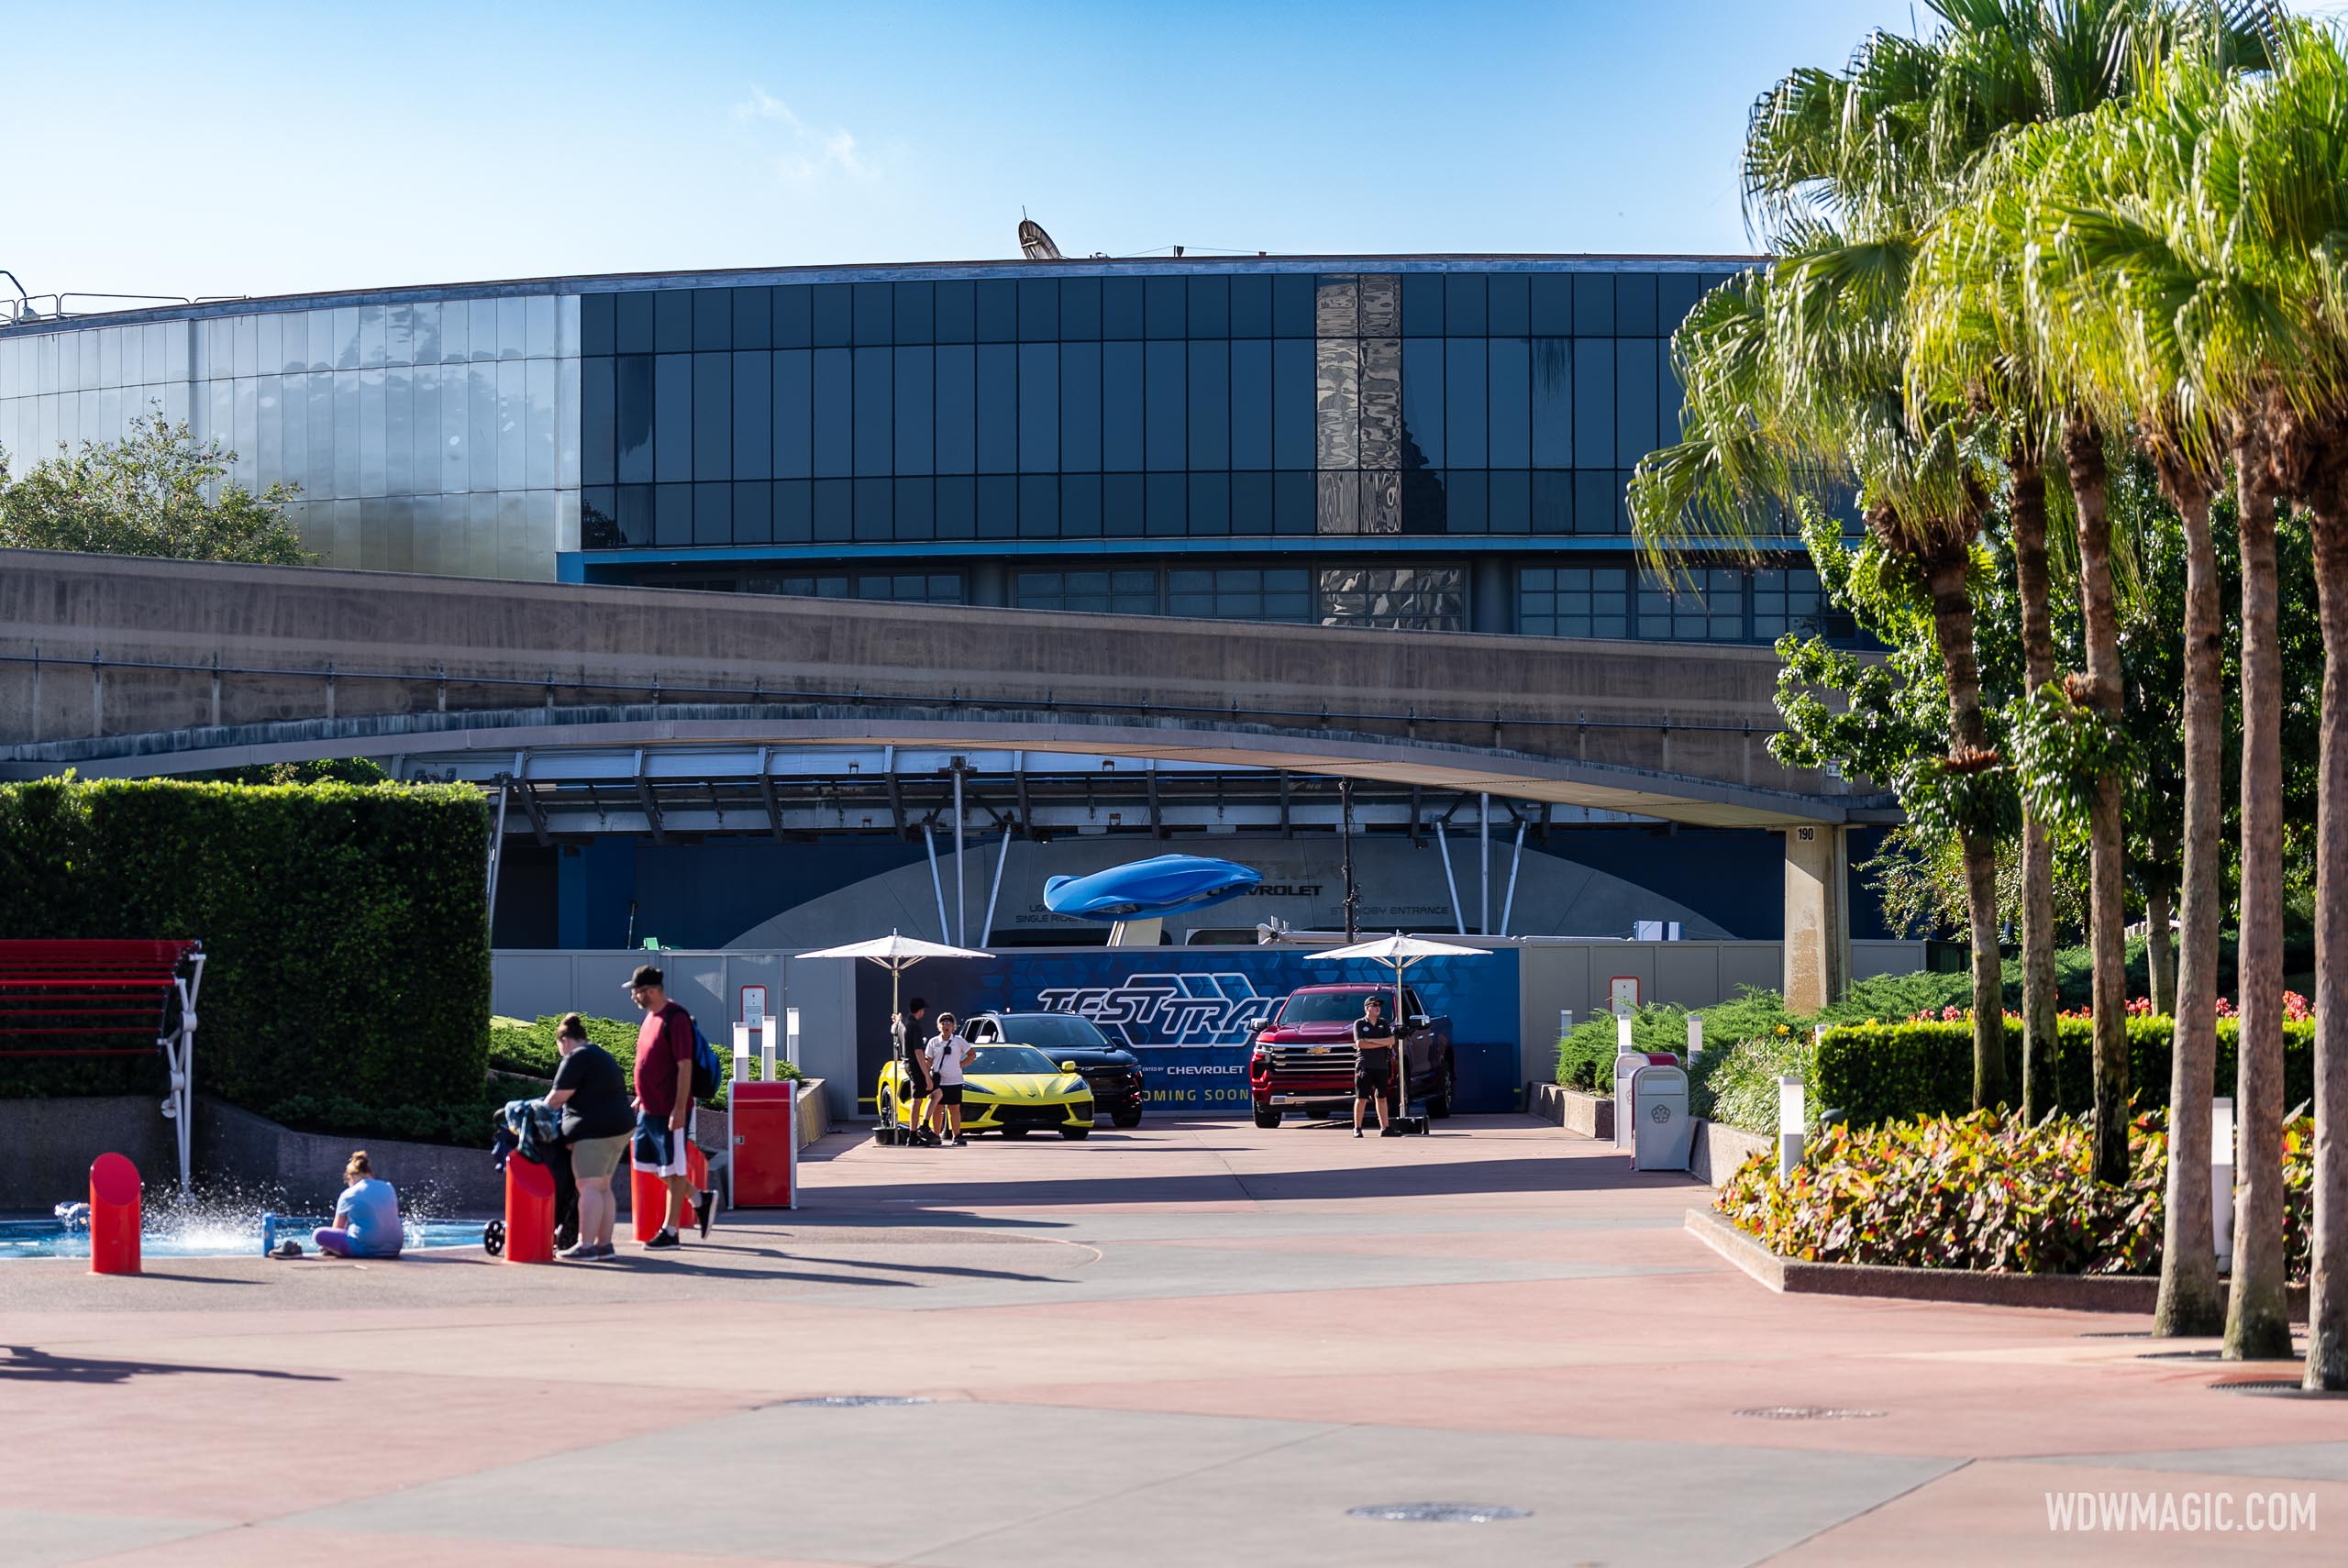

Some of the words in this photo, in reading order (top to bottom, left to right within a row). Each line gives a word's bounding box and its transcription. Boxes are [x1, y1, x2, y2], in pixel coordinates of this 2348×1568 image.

[1798, 827, 1814, 841] 190
[1390, 906, 1449, 915] ENTRANCE
[1015, 914, 1048, 923] SINGLE
[1037, 988, 1178, 1024] TEST
[1167, 1066, 1246, 1075] CHEVROLET
[1143, 1089, 1197, 1101] OMING
[1204, 1088, 1249, 1101] SOON
